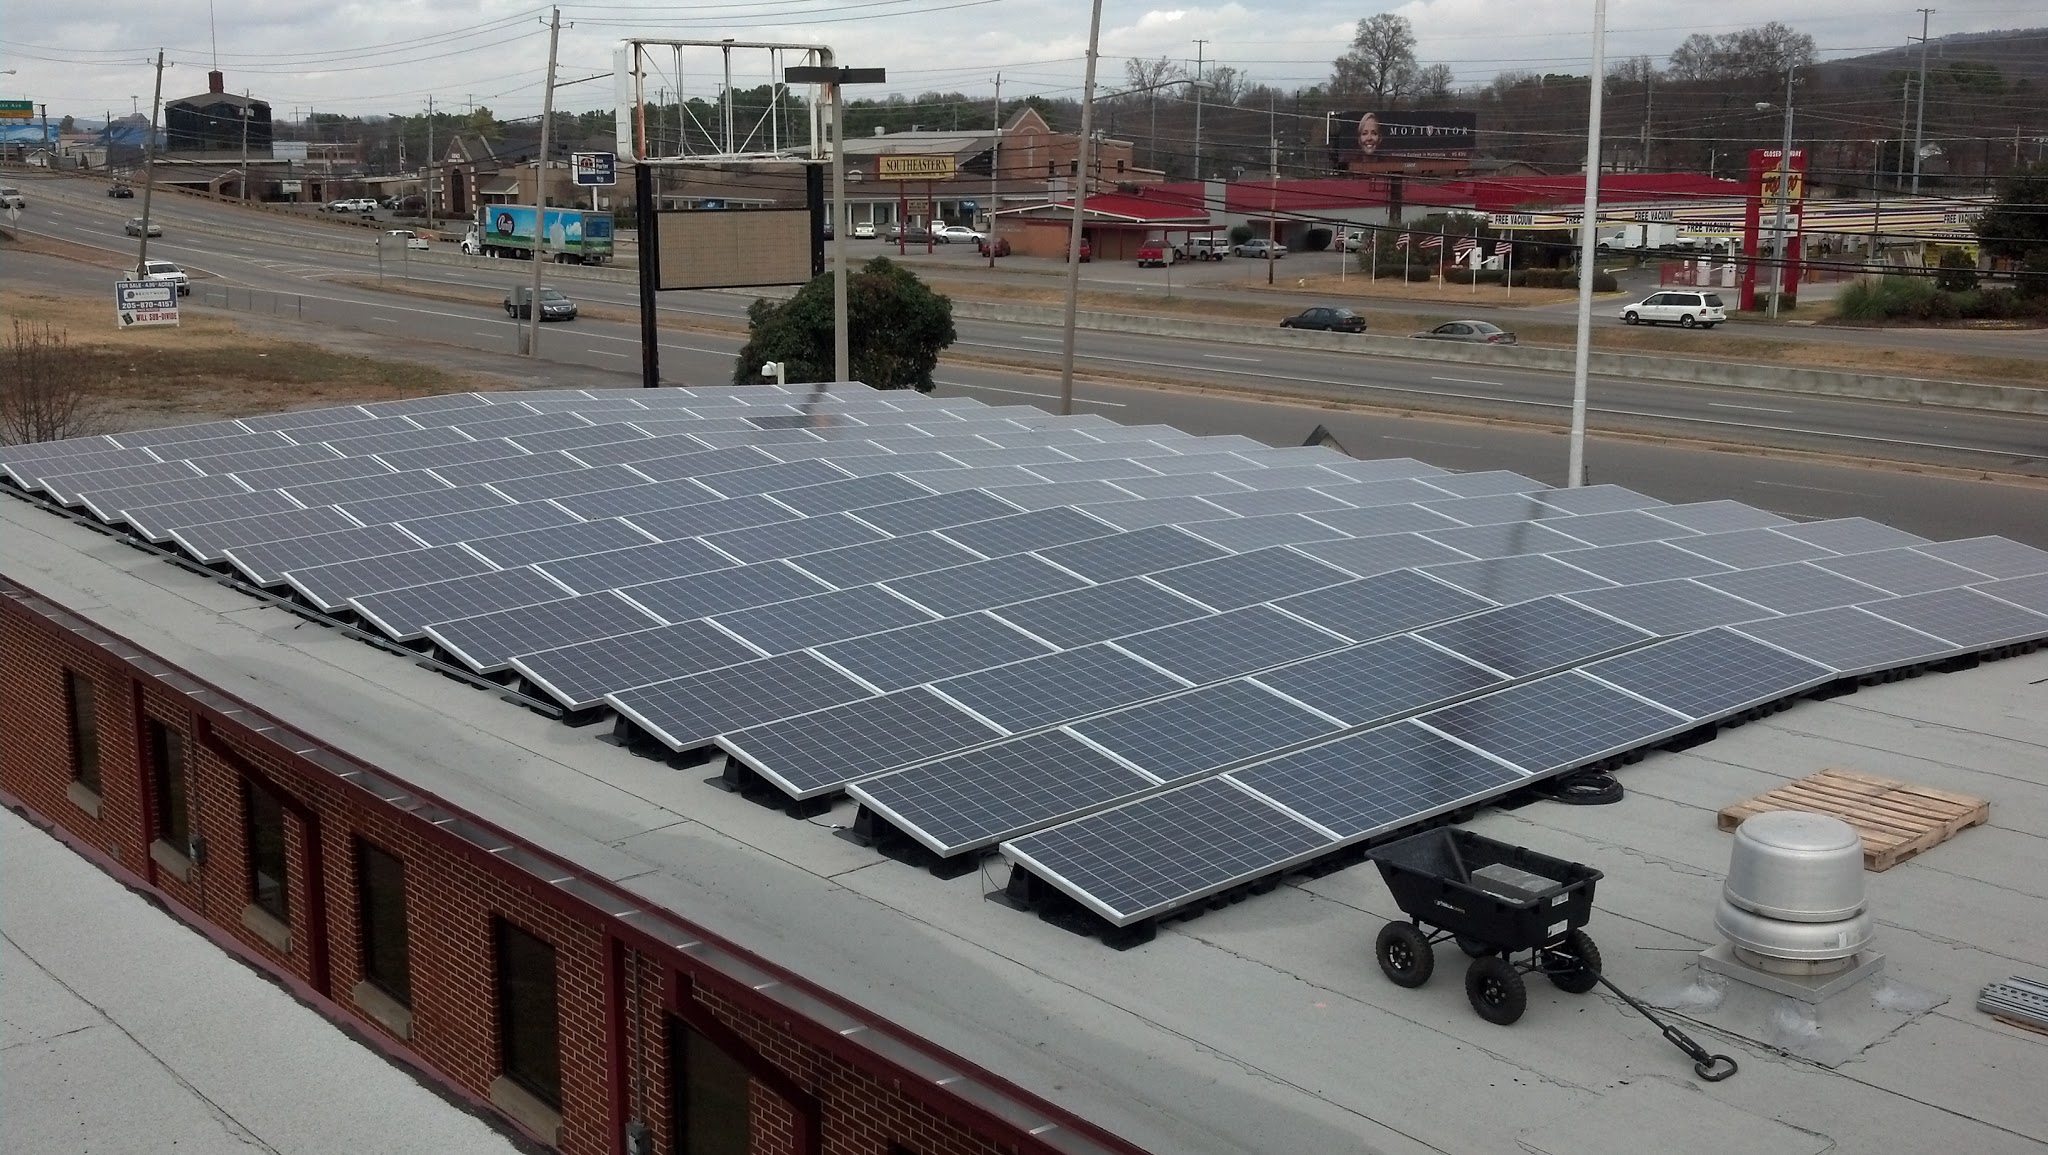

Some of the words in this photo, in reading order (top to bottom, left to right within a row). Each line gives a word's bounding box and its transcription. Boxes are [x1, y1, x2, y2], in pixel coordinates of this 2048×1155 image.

[1390, 126, 1468, 136] MOTIVATOR
[1763, 150, 1782, 158] CLOSED
[886, 160, 947, 171] SOUTHEASTERN
[1495, 215, 1509, 225] FREE
[1510, 215, 1533, 225] VACUUM
[1634, 211, 1649, 221] FREE
[1651, 210, 1674, 221] VACUUM
[1943, 214, 1957, 224] FREE
[1687, 222, 1703, 233] FREE
[1705, 222, 1731, 233] VACUUM
